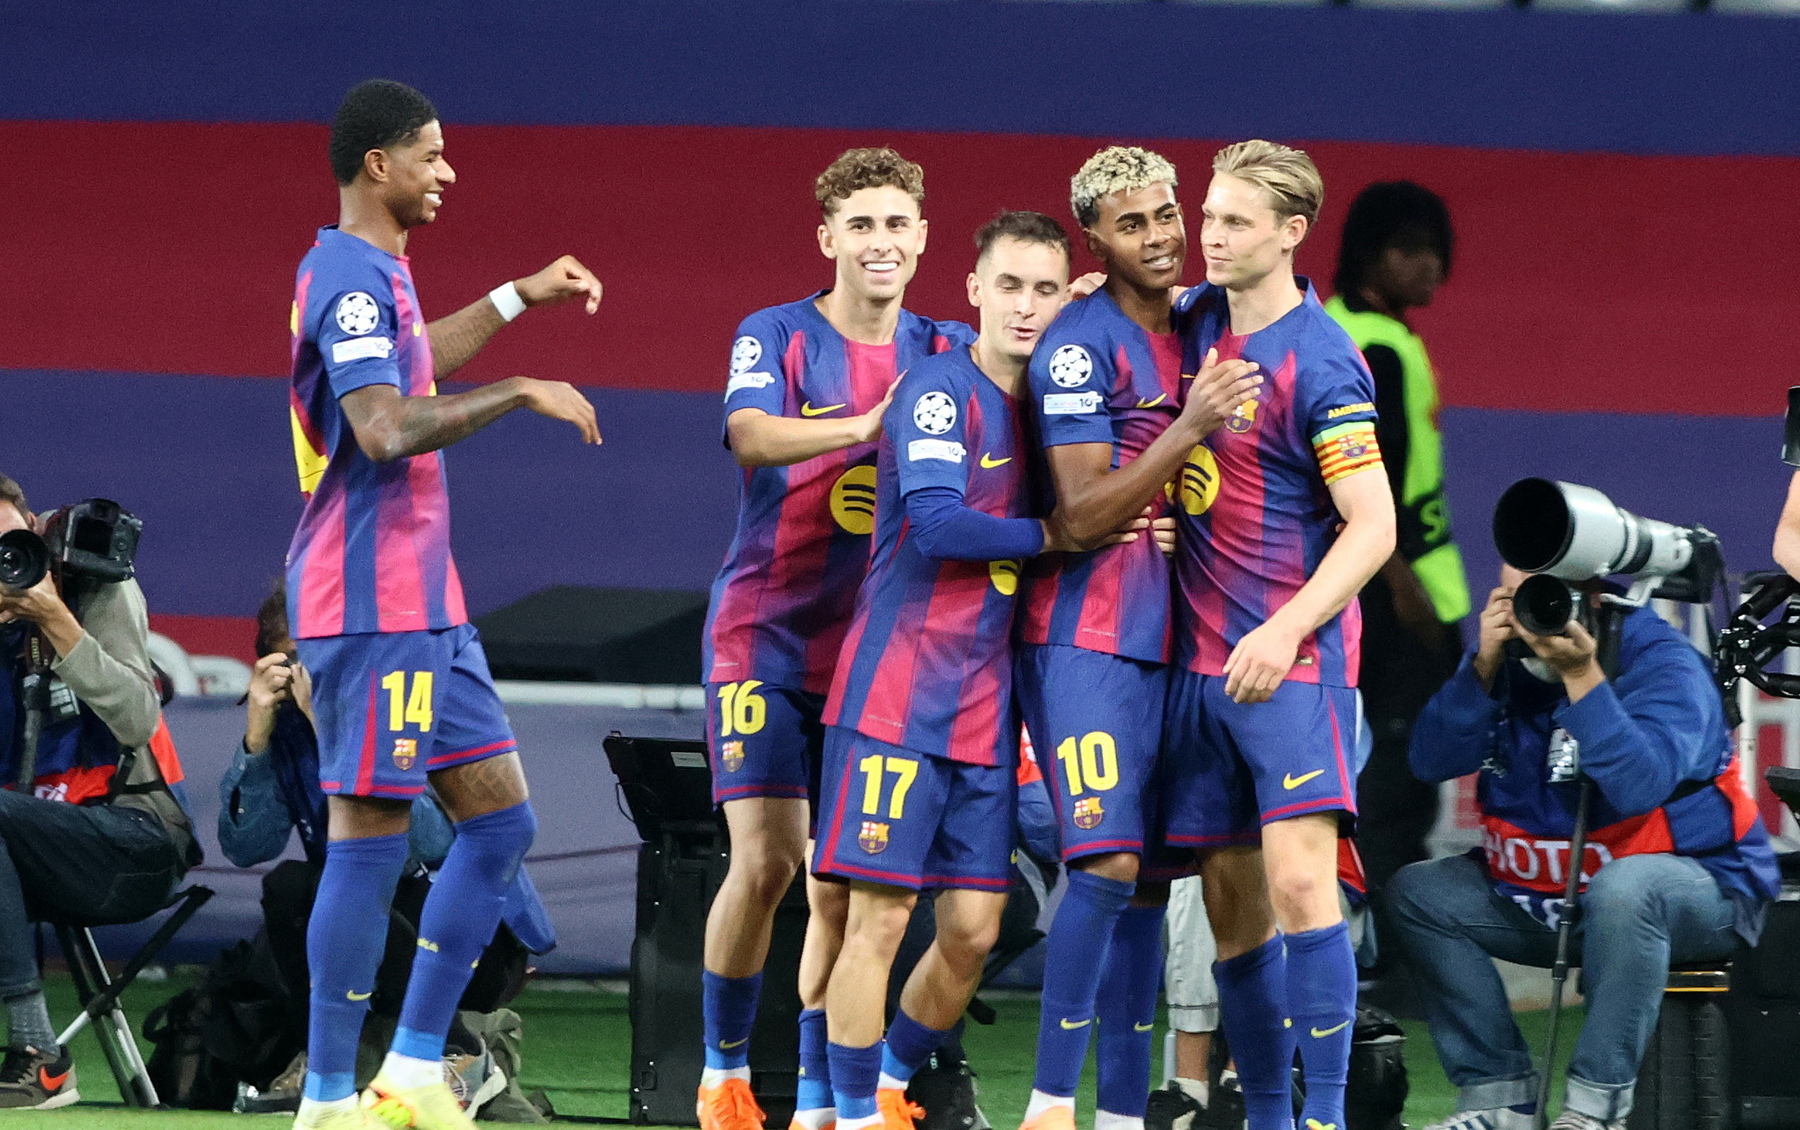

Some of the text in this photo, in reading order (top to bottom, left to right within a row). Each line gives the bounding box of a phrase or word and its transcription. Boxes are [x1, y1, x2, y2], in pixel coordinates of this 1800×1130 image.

[382, 670, 433, 733] 14
[717, 679, 766, 738] 16
[860, 754, 919, 820] 17
[1057, 731, 1120, 797] 10
